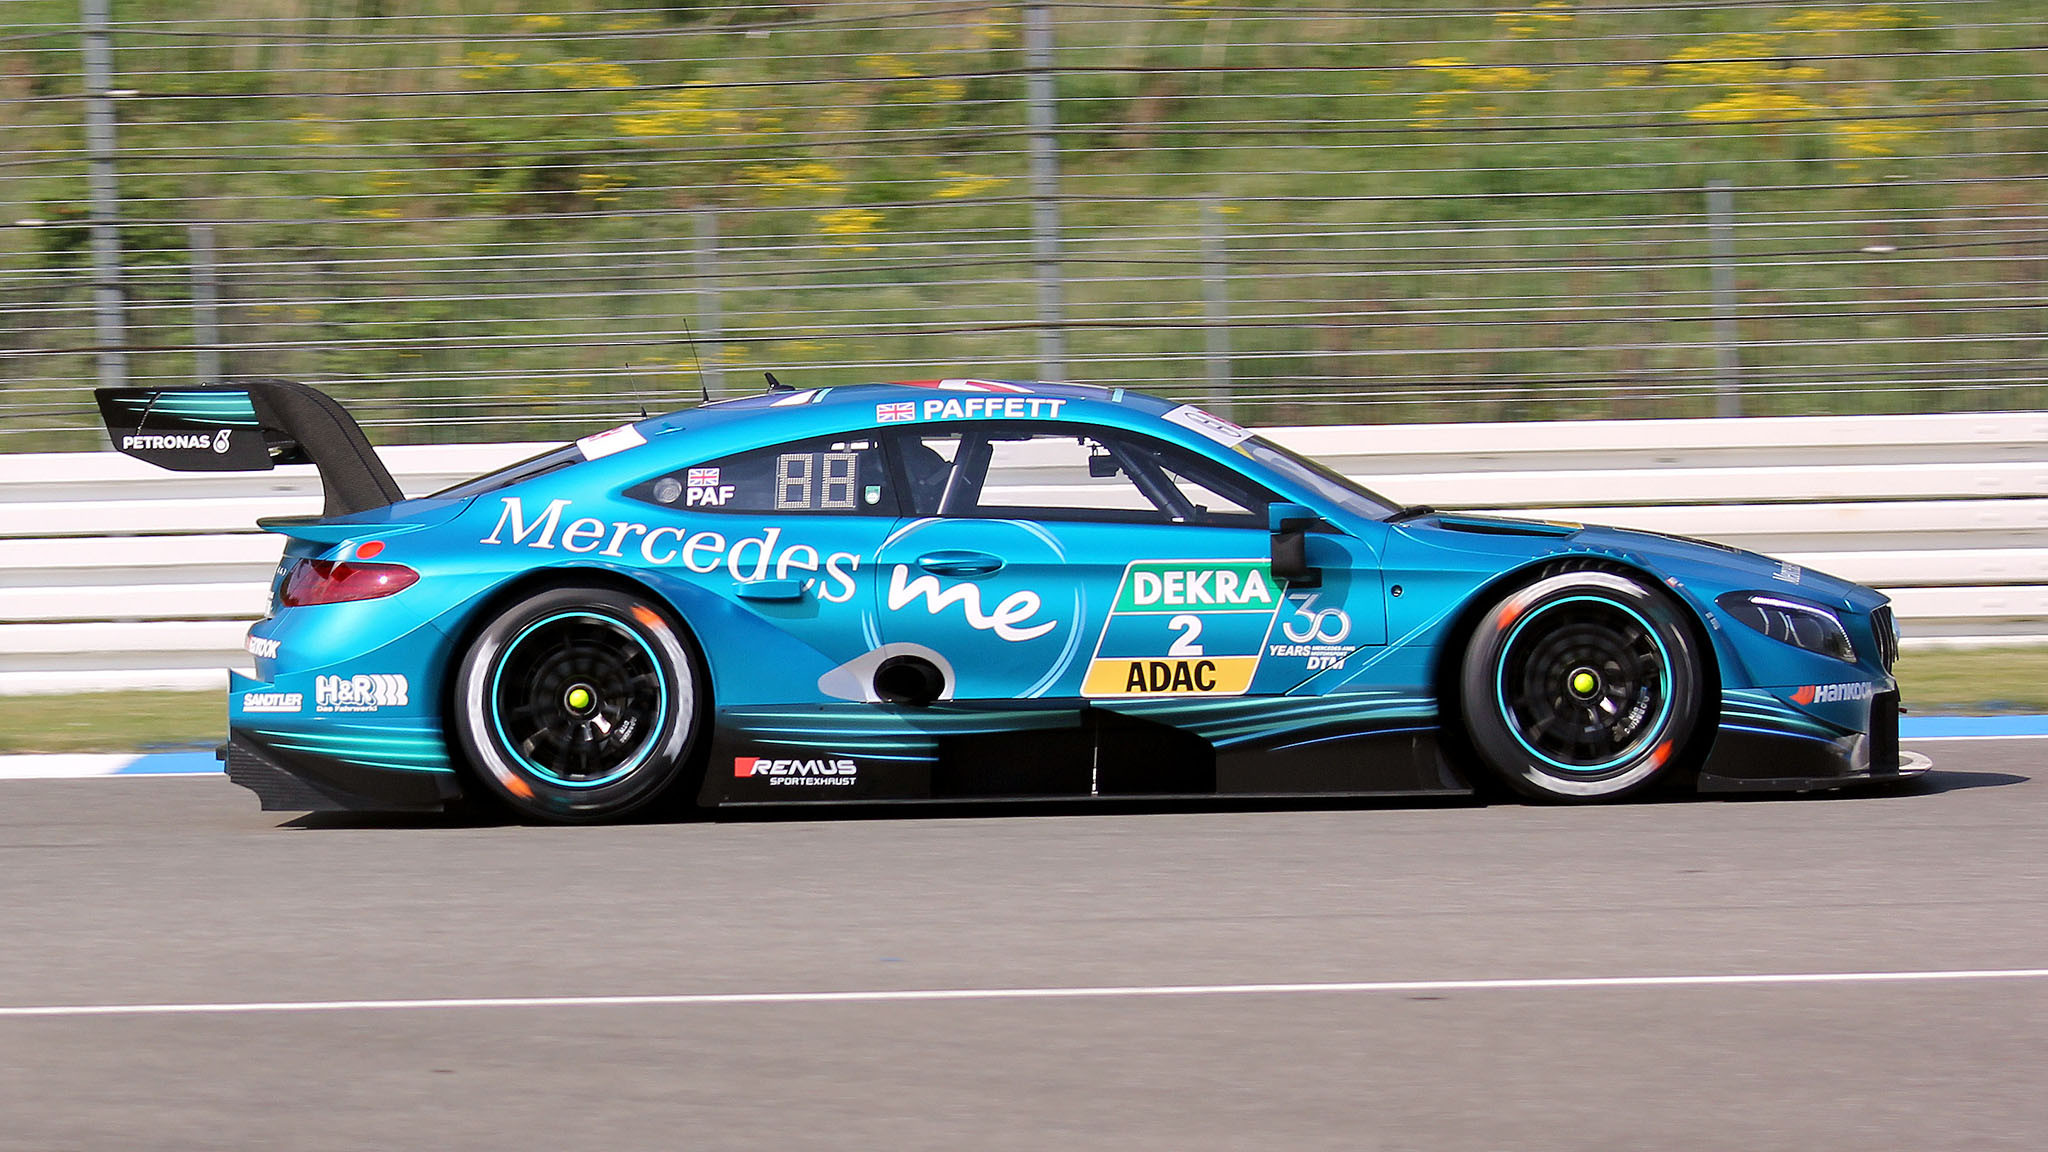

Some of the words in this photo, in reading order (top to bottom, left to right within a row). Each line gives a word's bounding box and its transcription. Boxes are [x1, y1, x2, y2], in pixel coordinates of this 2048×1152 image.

[923, 398, 1067, 420] PAFFETT
[122, 434, 211, 450] PETRONAS
[686, 486, 736, 507] PAF
[480, 497, 861, 603] Mercedes
[887, 563, 1058, 642] me
[1133, 569, 1272, 606] DEKRA
[1282, 593, 1352, 644] 30
[1167, 614, 1204, 657] 2
[1269, 645, 1311, 657] YEARS
[1306, 656, 1347, 670] DTM
[1126, 660, 1217, 693] ADAC
[244, 693, 303, 707] SANDTLER
[315, 674, 378, 707] H&R
[750, 759, 858, 776] REMUS
[769, 777, 857, 786] SPORTEXHAUST
